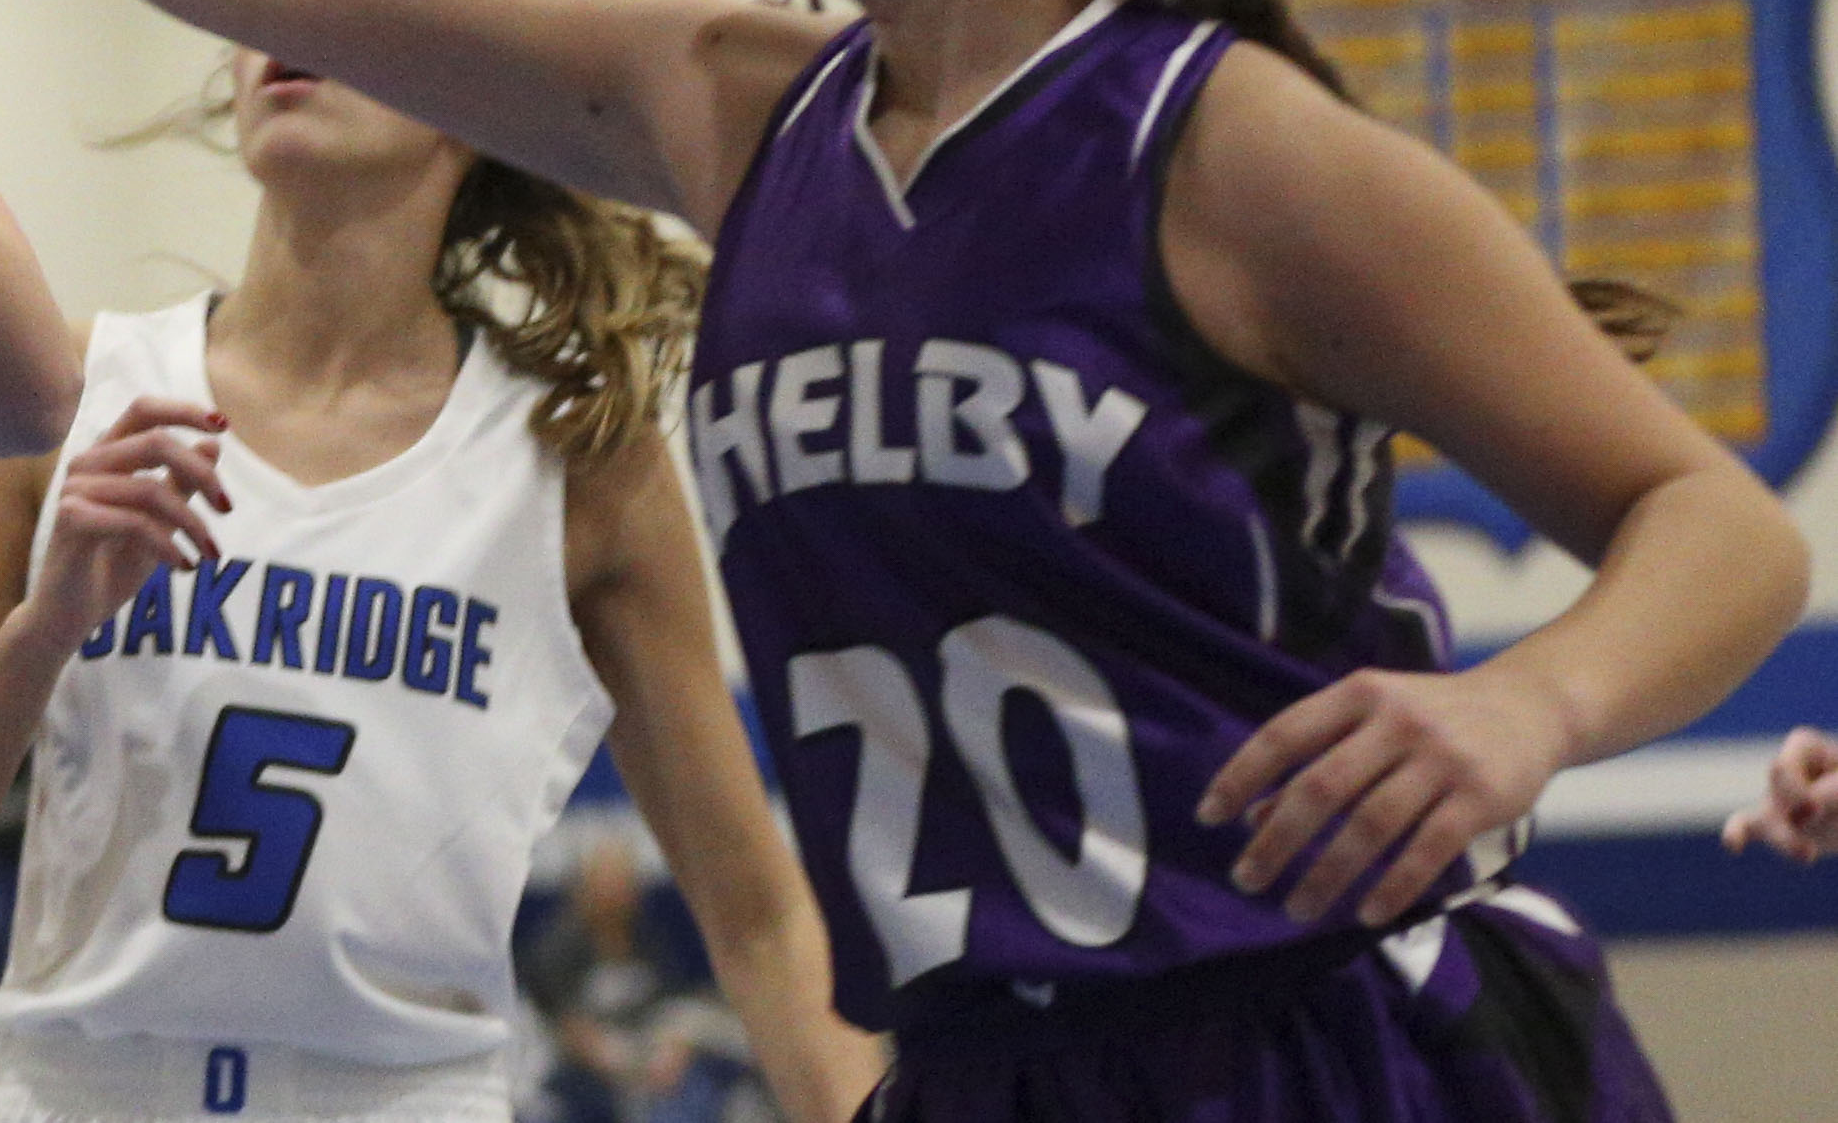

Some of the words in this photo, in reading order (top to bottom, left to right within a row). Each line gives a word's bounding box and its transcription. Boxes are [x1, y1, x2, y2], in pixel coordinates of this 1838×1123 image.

[691, 338, 1148, 557] HELBY
[162, 704, 357, 934] 5
[787, 614, 1148, 990] 20
